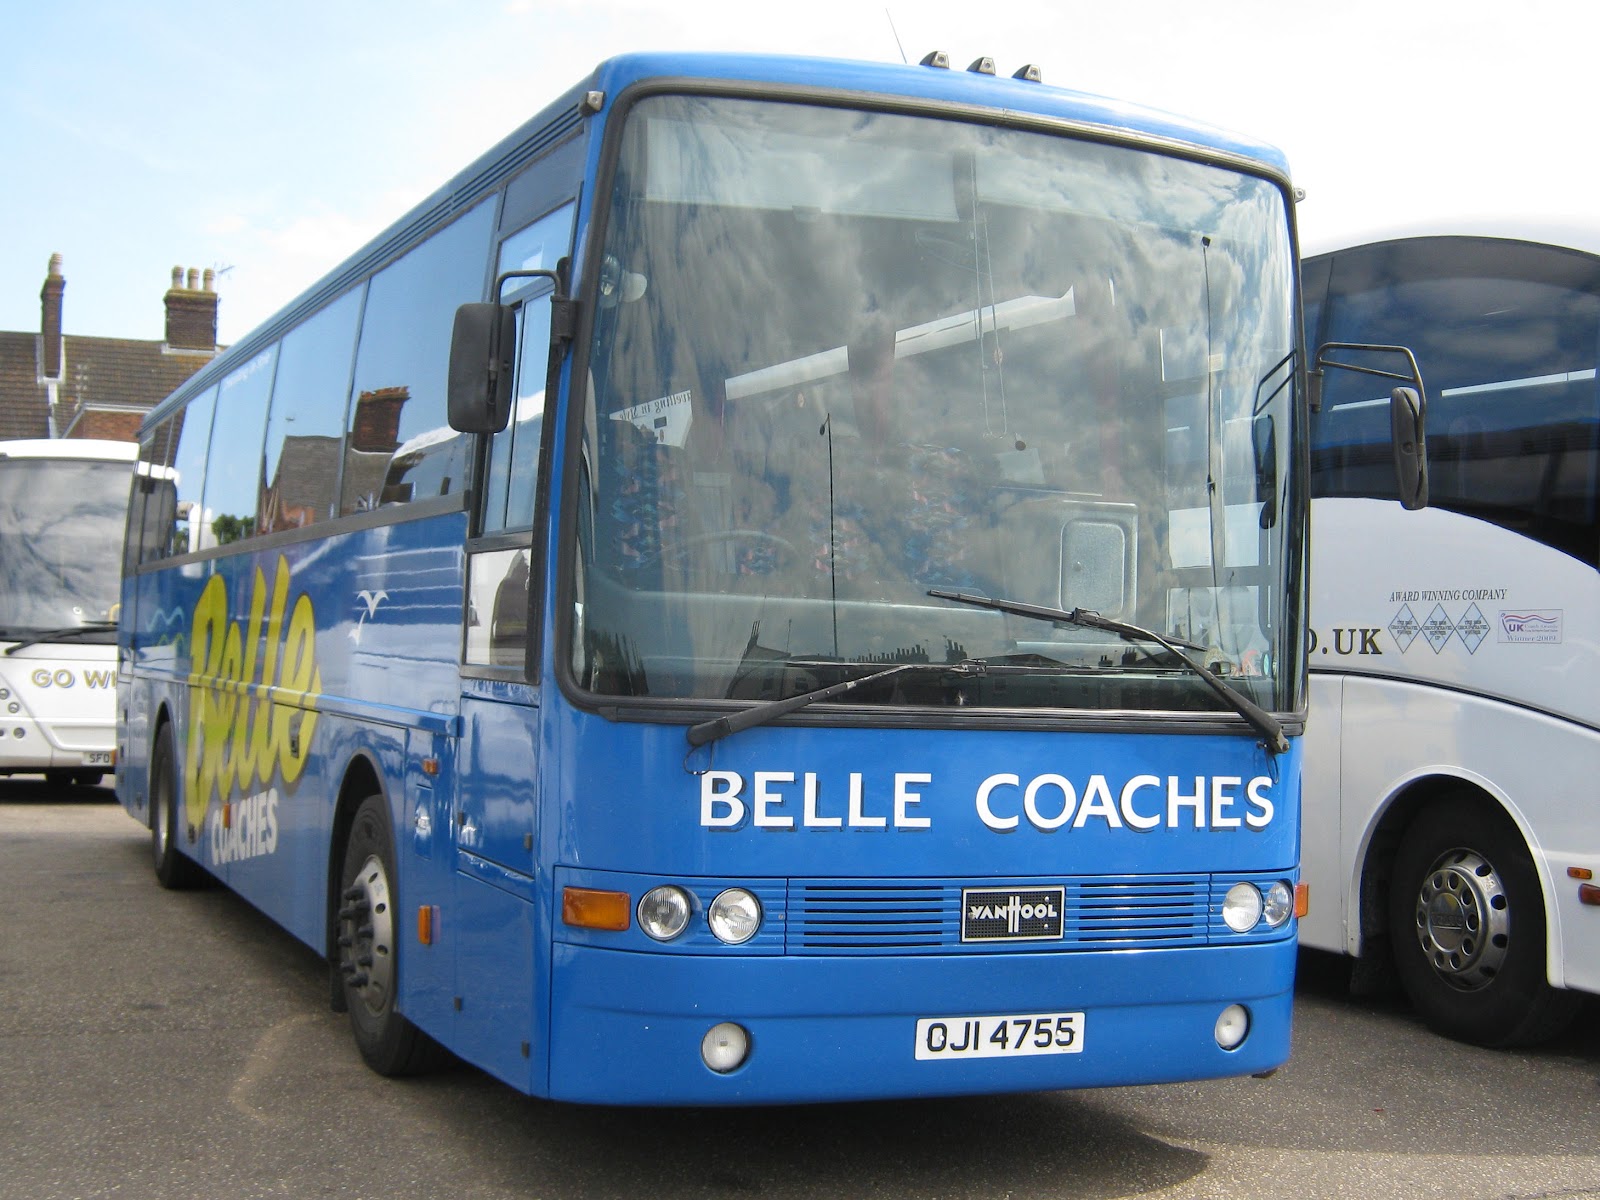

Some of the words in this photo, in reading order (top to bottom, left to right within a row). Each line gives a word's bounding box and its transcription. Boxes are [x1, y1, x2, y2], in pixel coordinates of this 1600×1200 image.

[1389, 591, 1420, 602] AWARD
[1421, 590, 1460, 601] WINNING
[1462, 589, 1507, 600] COMPANY
[1508, 624, 1524, 632] UK
[31, 668, 75, 688] GO
[700, 770, 933, 830] BELLE
[974, 773, 1276, 831] COACHES
[211, 787, 278, 866] COACHES
[989, 1017, 1076, 1051] 4755
